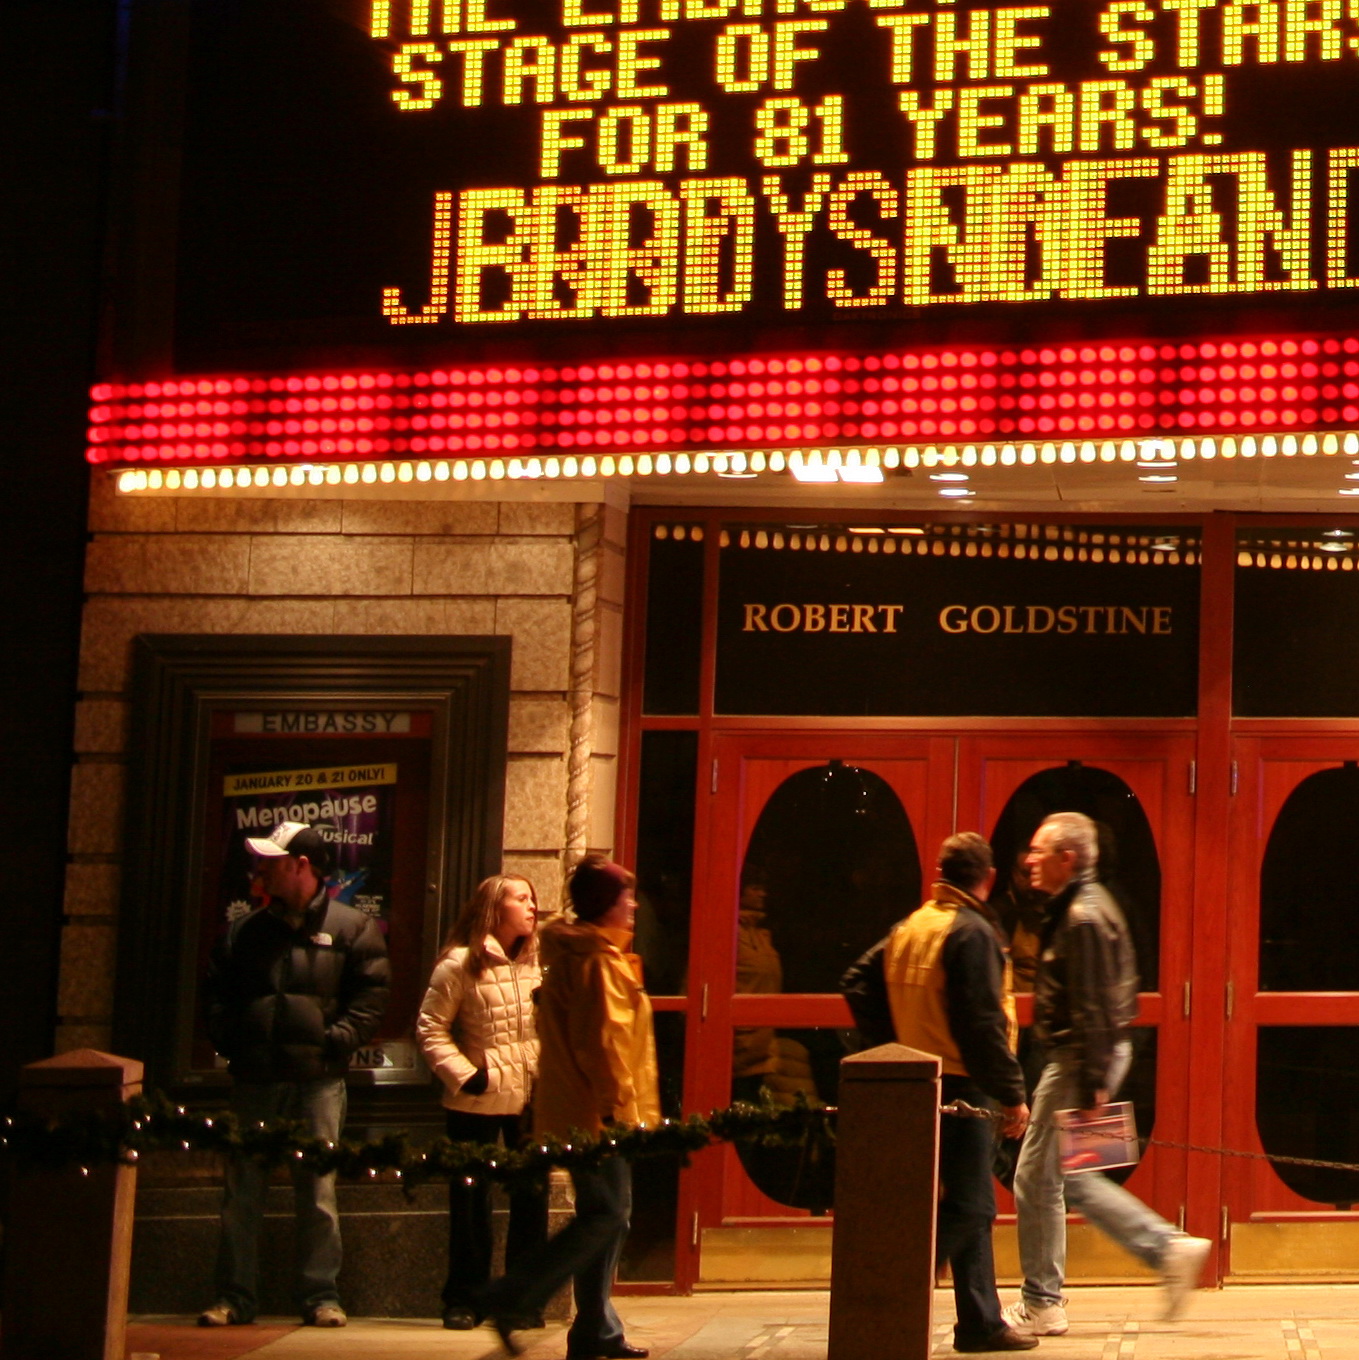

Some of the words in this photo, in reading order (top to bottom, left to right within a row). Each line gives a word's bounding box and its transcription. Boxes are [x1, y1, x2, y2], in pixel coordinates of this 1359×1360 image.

[391, 29, 671, 110] STAGE
[716, 20, 829, 93] OF
[876, 6, 1050, 84] THE
[540, 103, 710, 178] FOR
[754, 95, 851, 167] 81
[899, 74, 1226, 159] YEARS!
[742, 603, 904, 634] ROBERT
[938, 604, 1171, 635] GOLDSTINE
[261, 712, 398, 733] EMBASSY
[233, 774, 292, 791] JANUARY
[295, 774, 313, 787] 20
[332, 770, 345, 783] 21
[347, 767, 386, 783] ONLY!
[236, 793, 378, 830] Menopause
